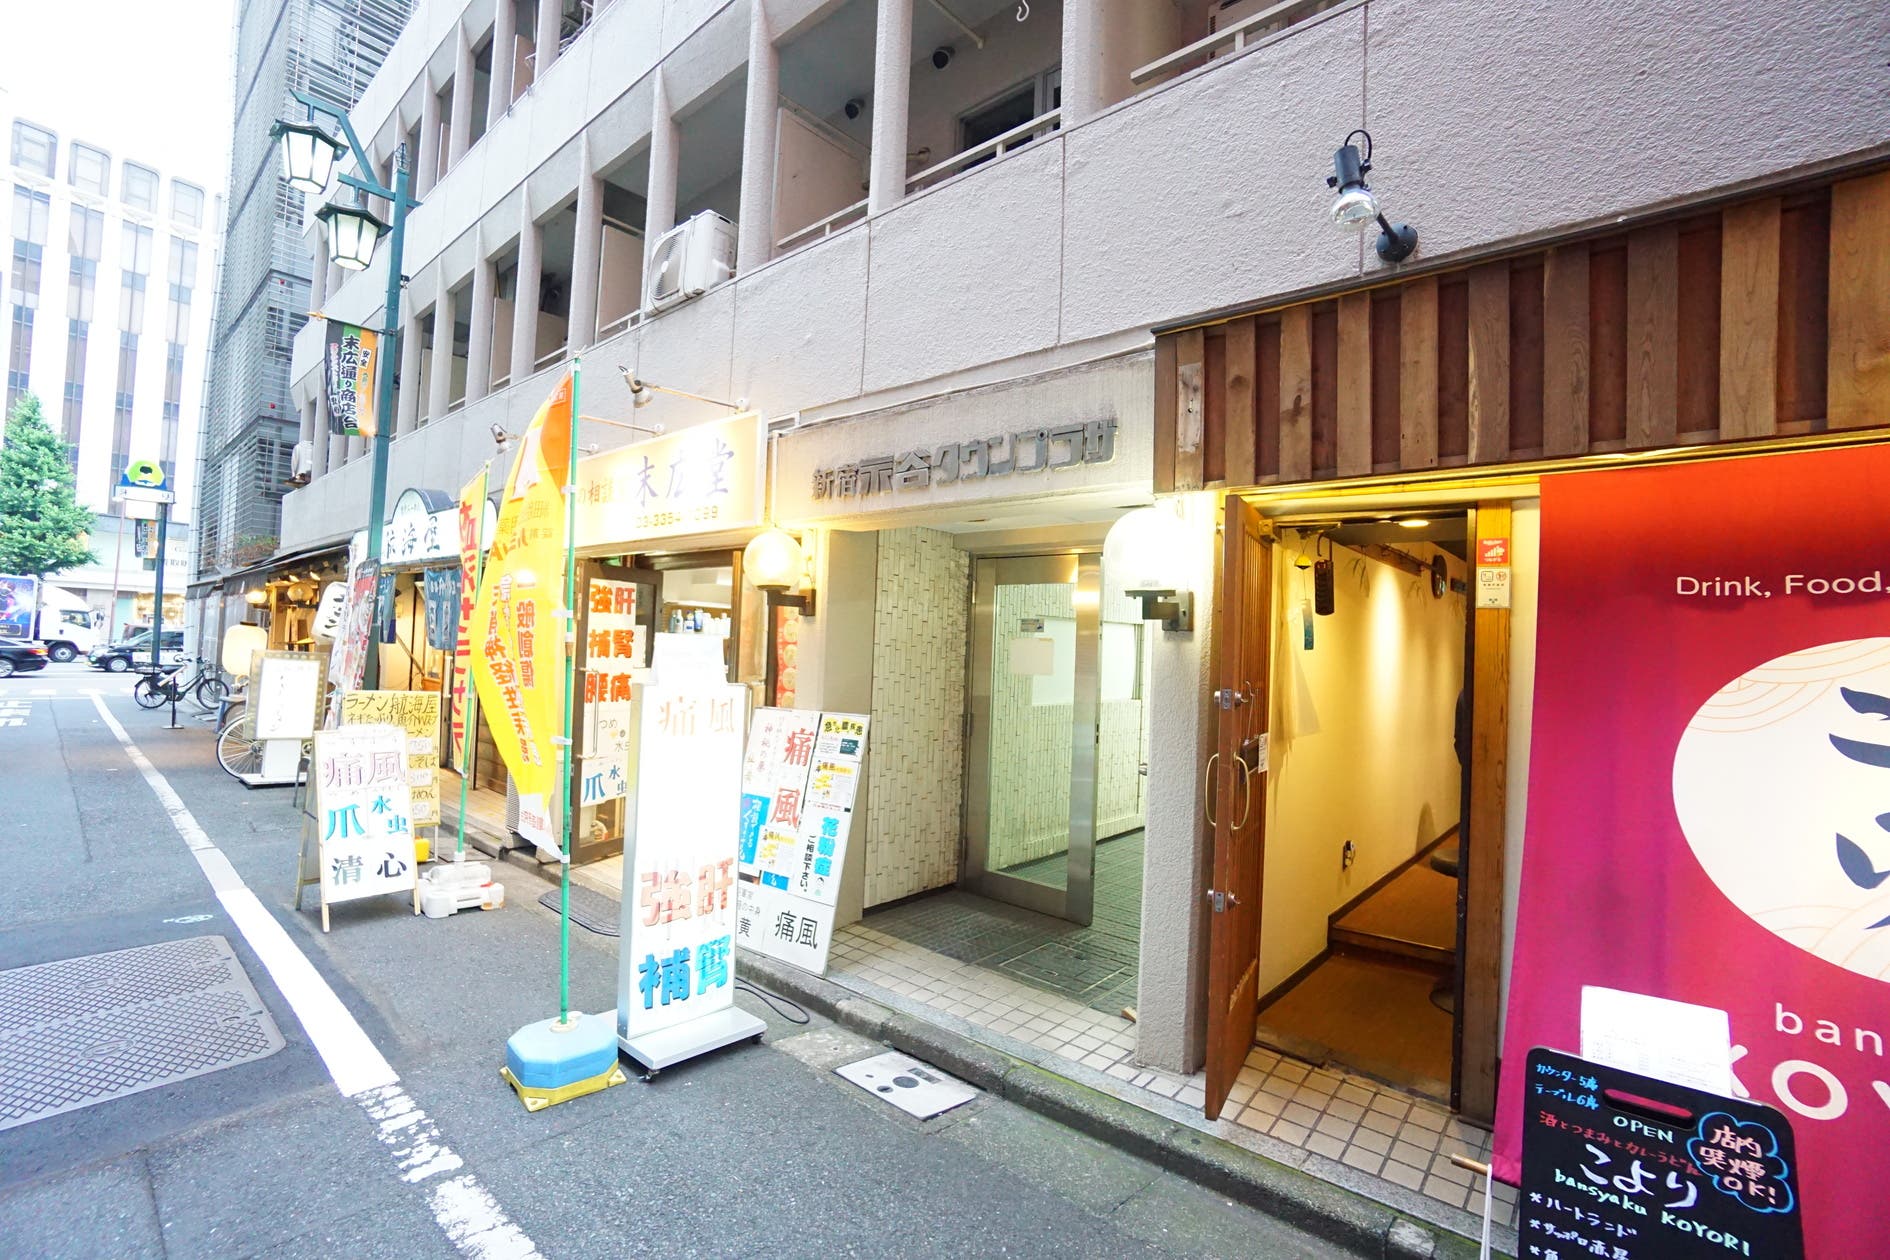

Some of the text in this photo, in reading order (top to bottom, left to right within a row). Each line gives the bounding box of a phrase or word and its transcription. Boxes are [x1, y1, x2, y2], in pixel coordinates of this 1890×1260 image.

[589, 583, 636, 615] 強肝
[1676, 575, 1772, 599] Drink,
[346, 692, 438, 715] ラーメン航海屋
[584, 672, 632, 704] 腰痛
[657, 696, 735, 737] 痛風
[324, 752, 407, 788] 痛風
[770, 727, 815, 830] 痛風
[331, 851, 408, 886] 清心
[640, 856, 734, 927] 強肝
[774, 910, 818, 949] 痛風
[638, 934, 732, 1010] 補腎
[1612, 1115, 1675, 1143] OPEN
[1708, 1124, 1763, 1159] 店内
[1554, 1168, 1648, 1217] bansyaku
[1579, 1143, 1698, 1208] こより
